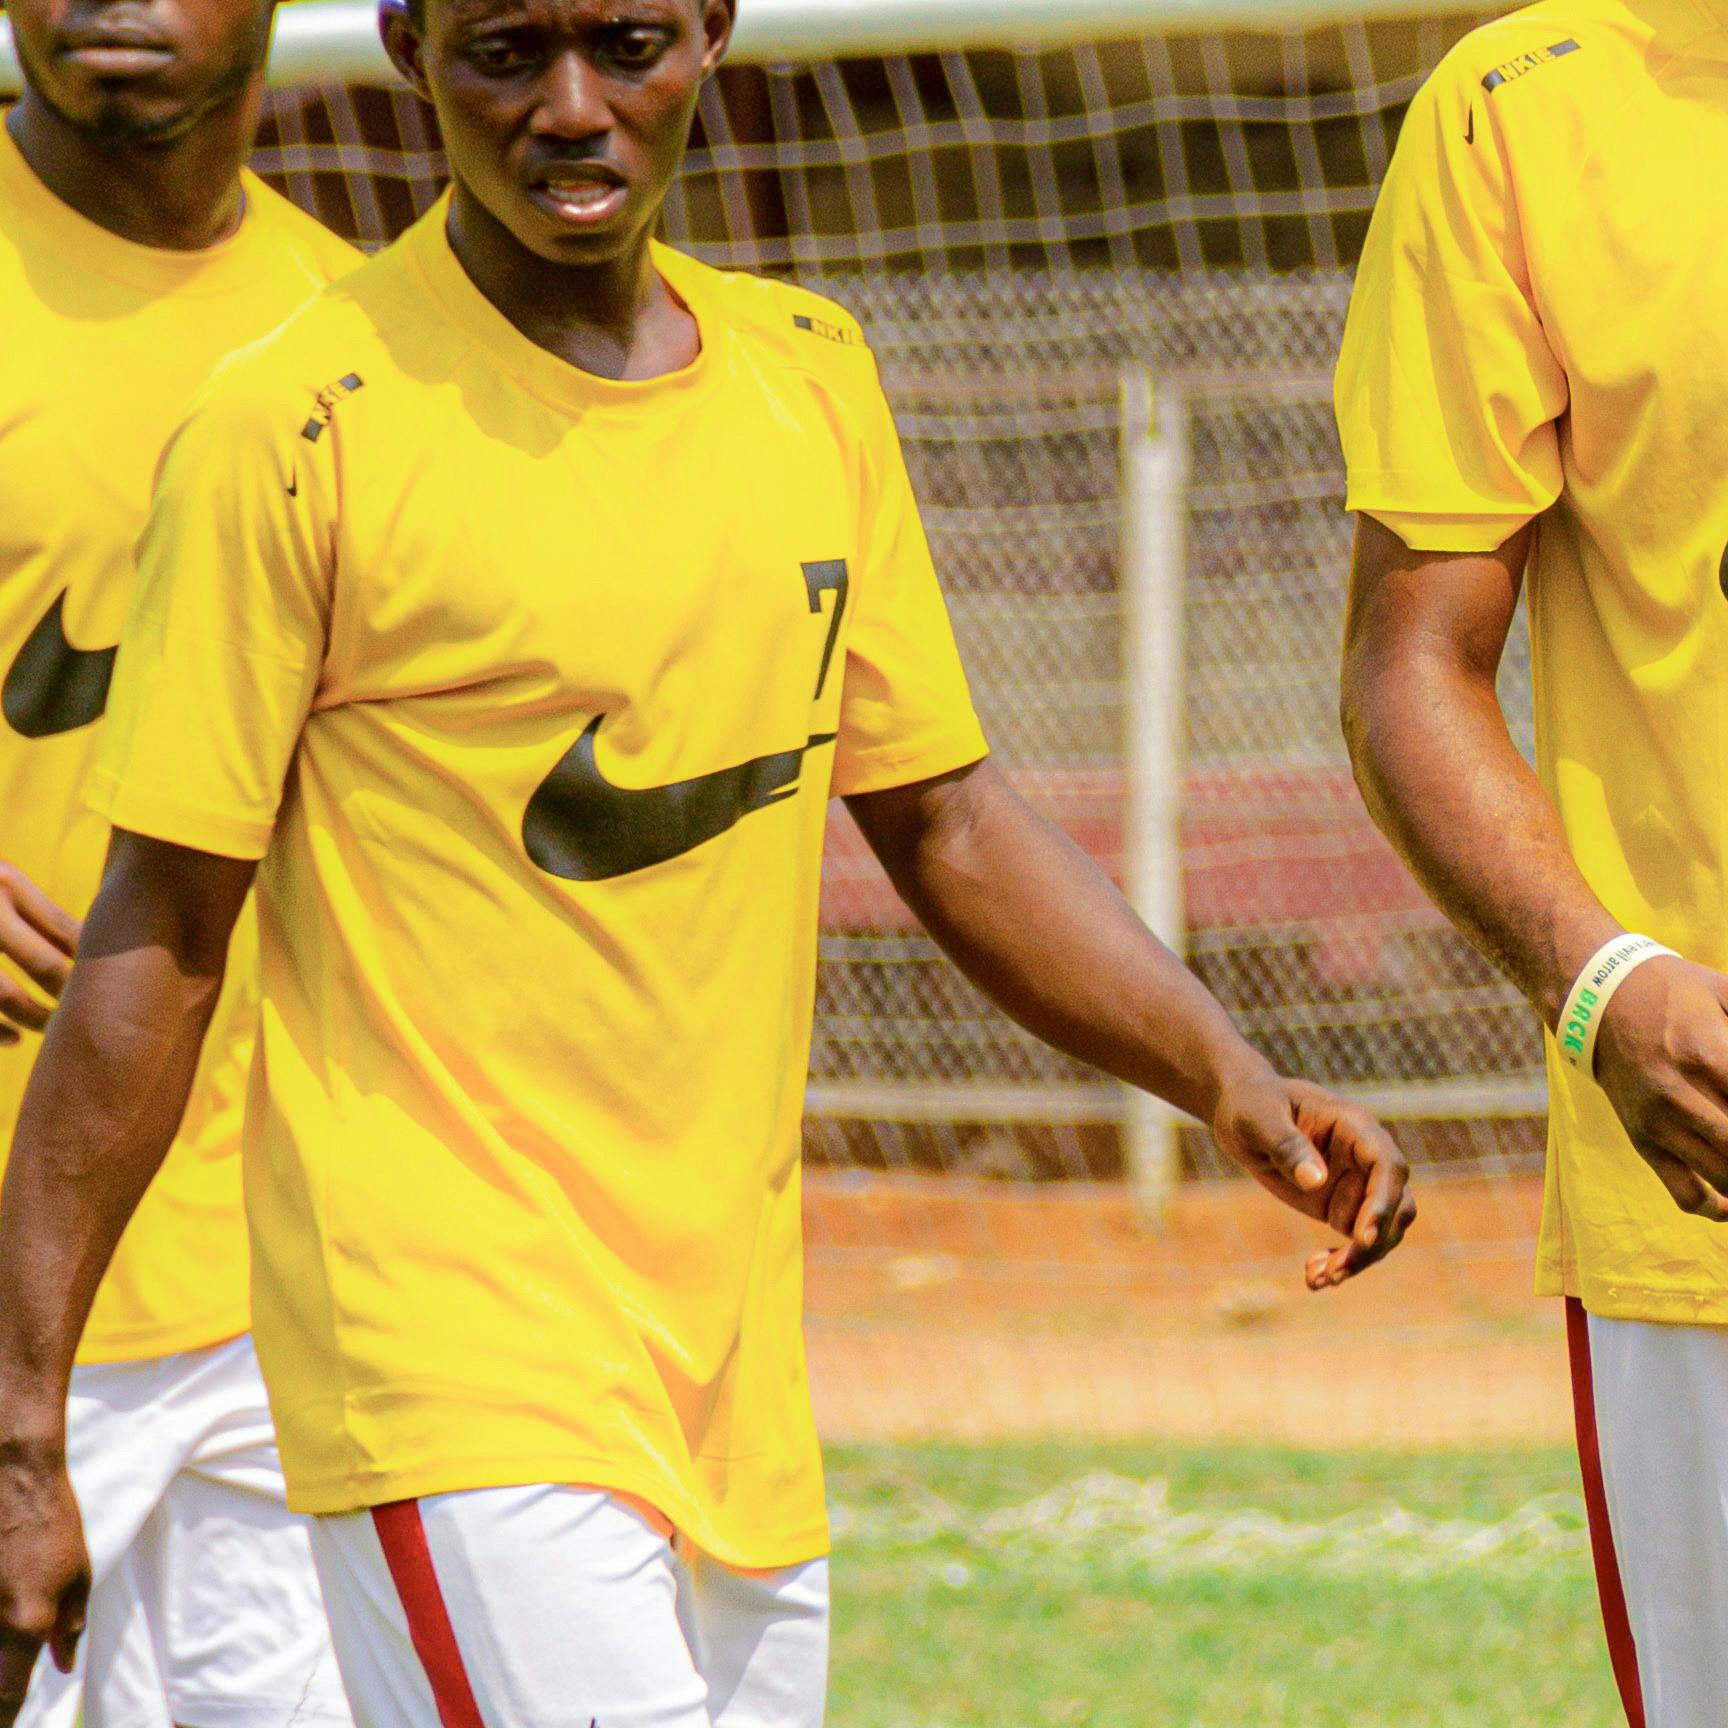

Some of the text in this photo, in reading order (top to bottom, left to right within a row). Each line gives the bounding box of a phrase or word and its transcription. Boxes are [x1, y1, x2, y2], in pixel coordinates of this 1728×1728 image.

[800, 558, 849, 700] 7
[1592, 957, 1620, 987] arrow
[1564, 989, 1599, 1054] BACK
